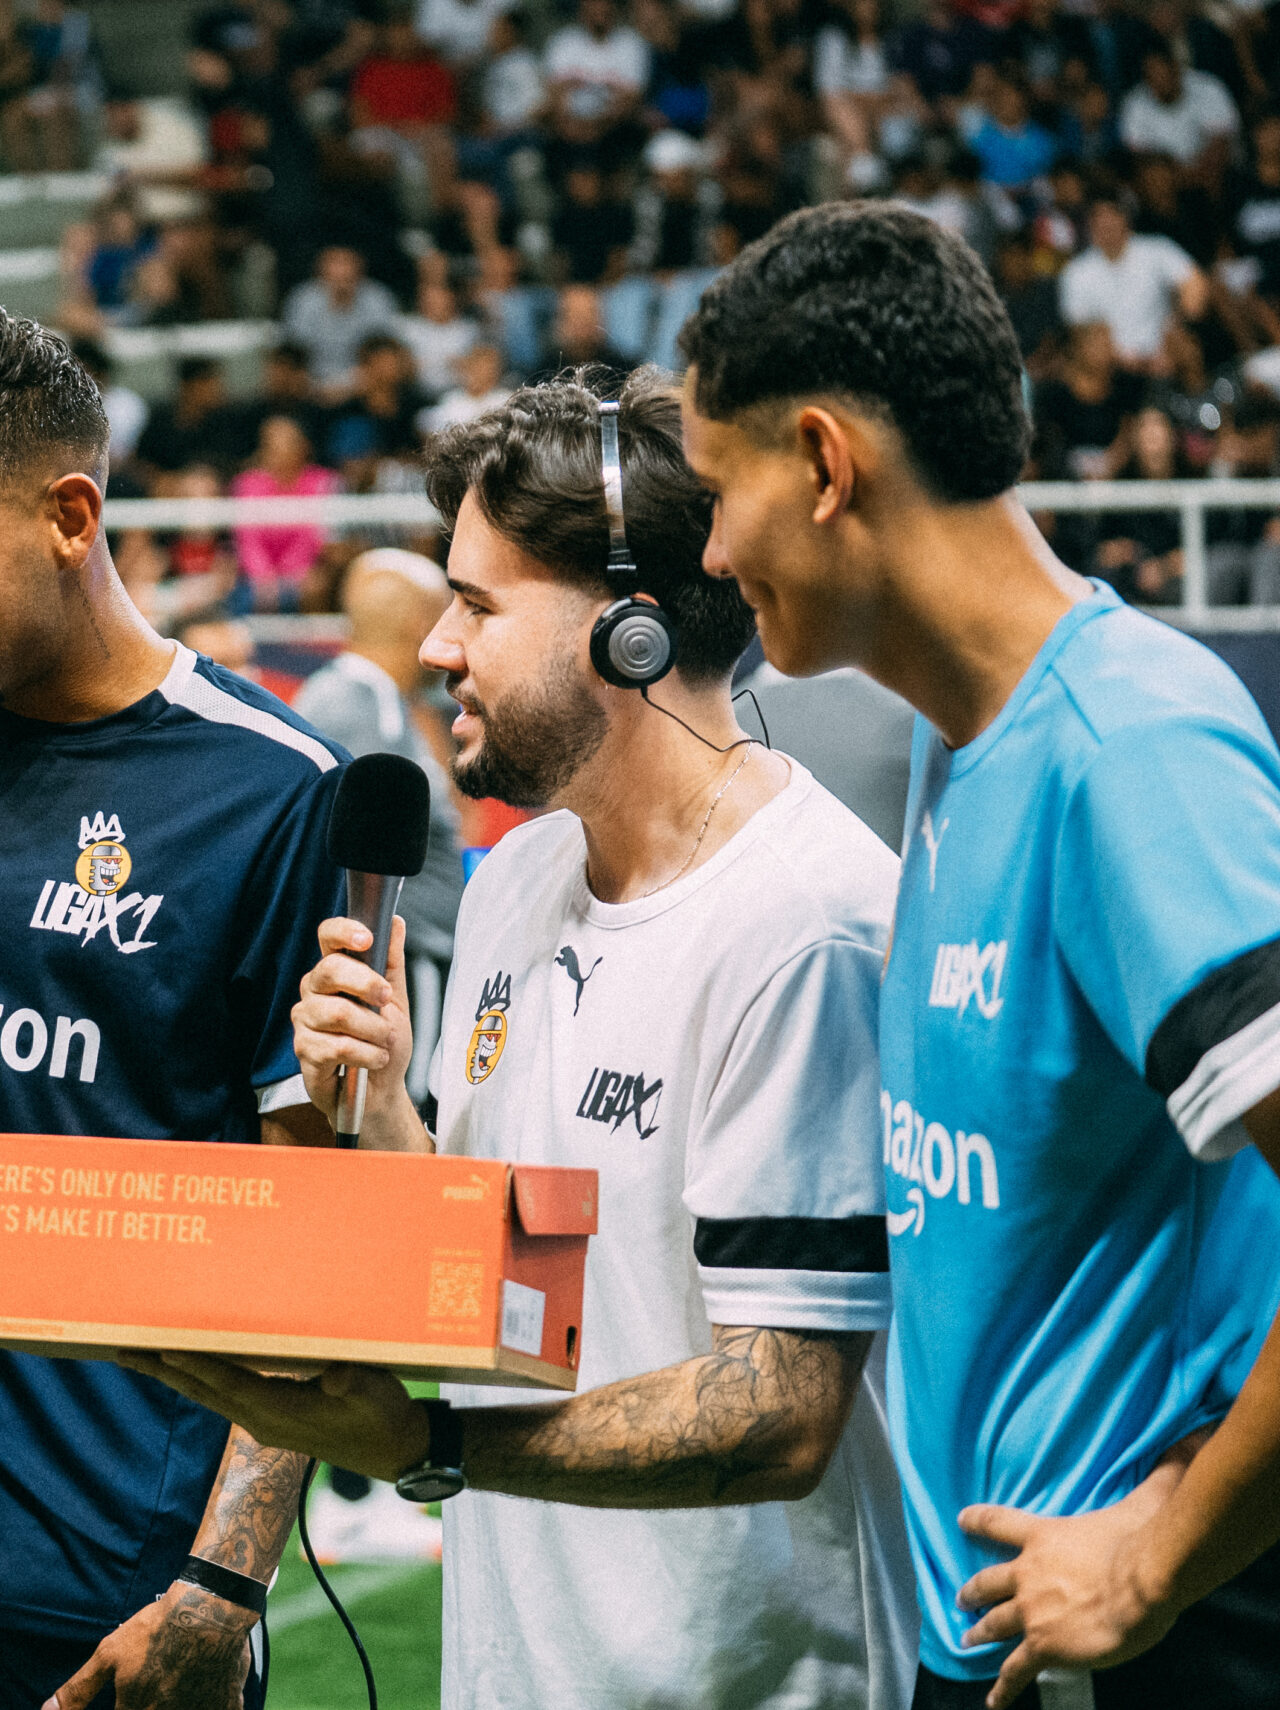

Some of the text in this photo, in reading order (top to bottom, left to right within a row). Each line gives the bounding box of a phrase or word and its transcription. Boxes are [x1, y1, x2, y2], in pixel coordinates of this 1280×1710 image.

[880, 1089, 1000, 1210] azon
[61, 1168, 118, 1198] ONLY
[121, 1171, 166, 1201] ONE
[172, 1174, 280, 1208] FOREVER.
[25, 1206, 91, 1237] MAKE
[96, 1210, 118, 1238] IT
[122, 1212, 213, 1244] BETTER.
